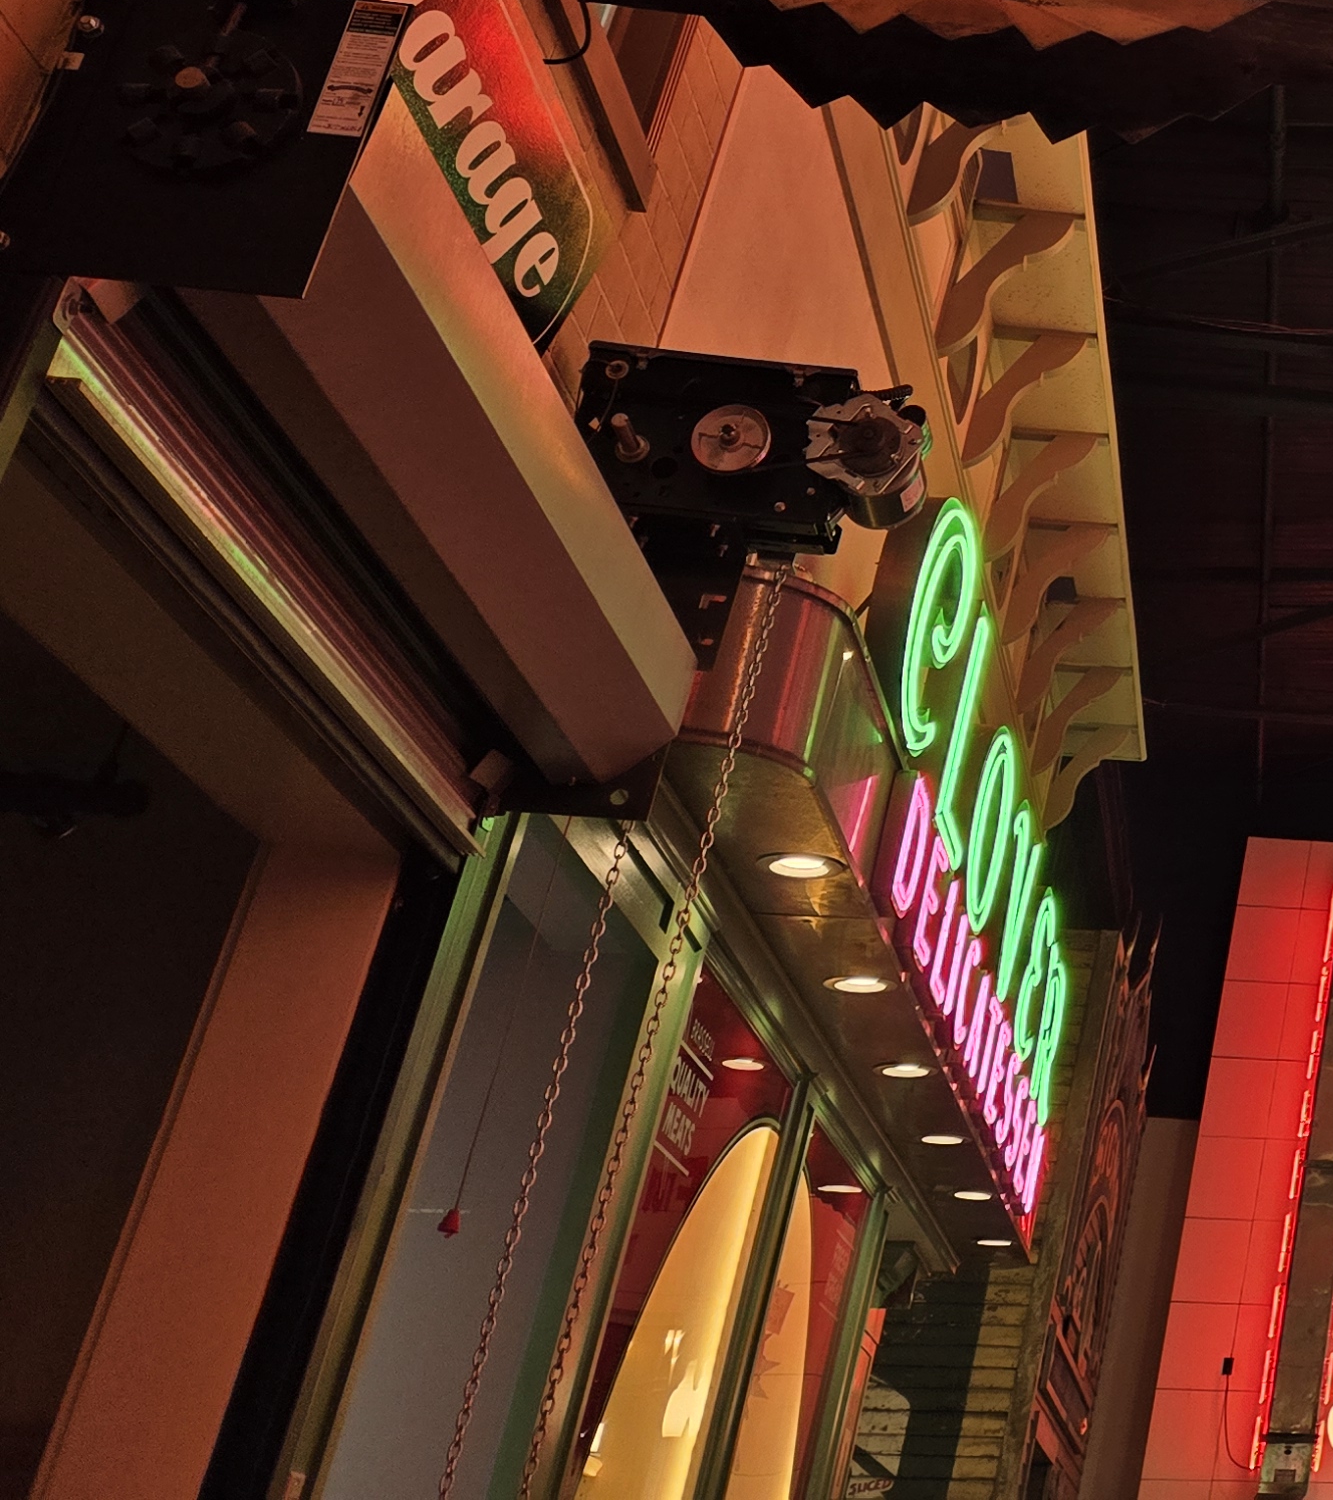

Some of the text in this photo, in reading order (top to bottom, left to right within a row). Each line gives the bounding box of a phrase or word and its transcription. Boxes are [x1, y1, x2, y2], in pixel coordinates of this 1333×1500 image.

[899, 495, 1068, 1128] CLOVER
[890, 772, 1048, 1216] DELICATESSEN
[670, 1055, 710, 1119] QUALITY
[661, 1102, 696, 1156] MEATS
[847, 1478, 892, 1497] SLICED
